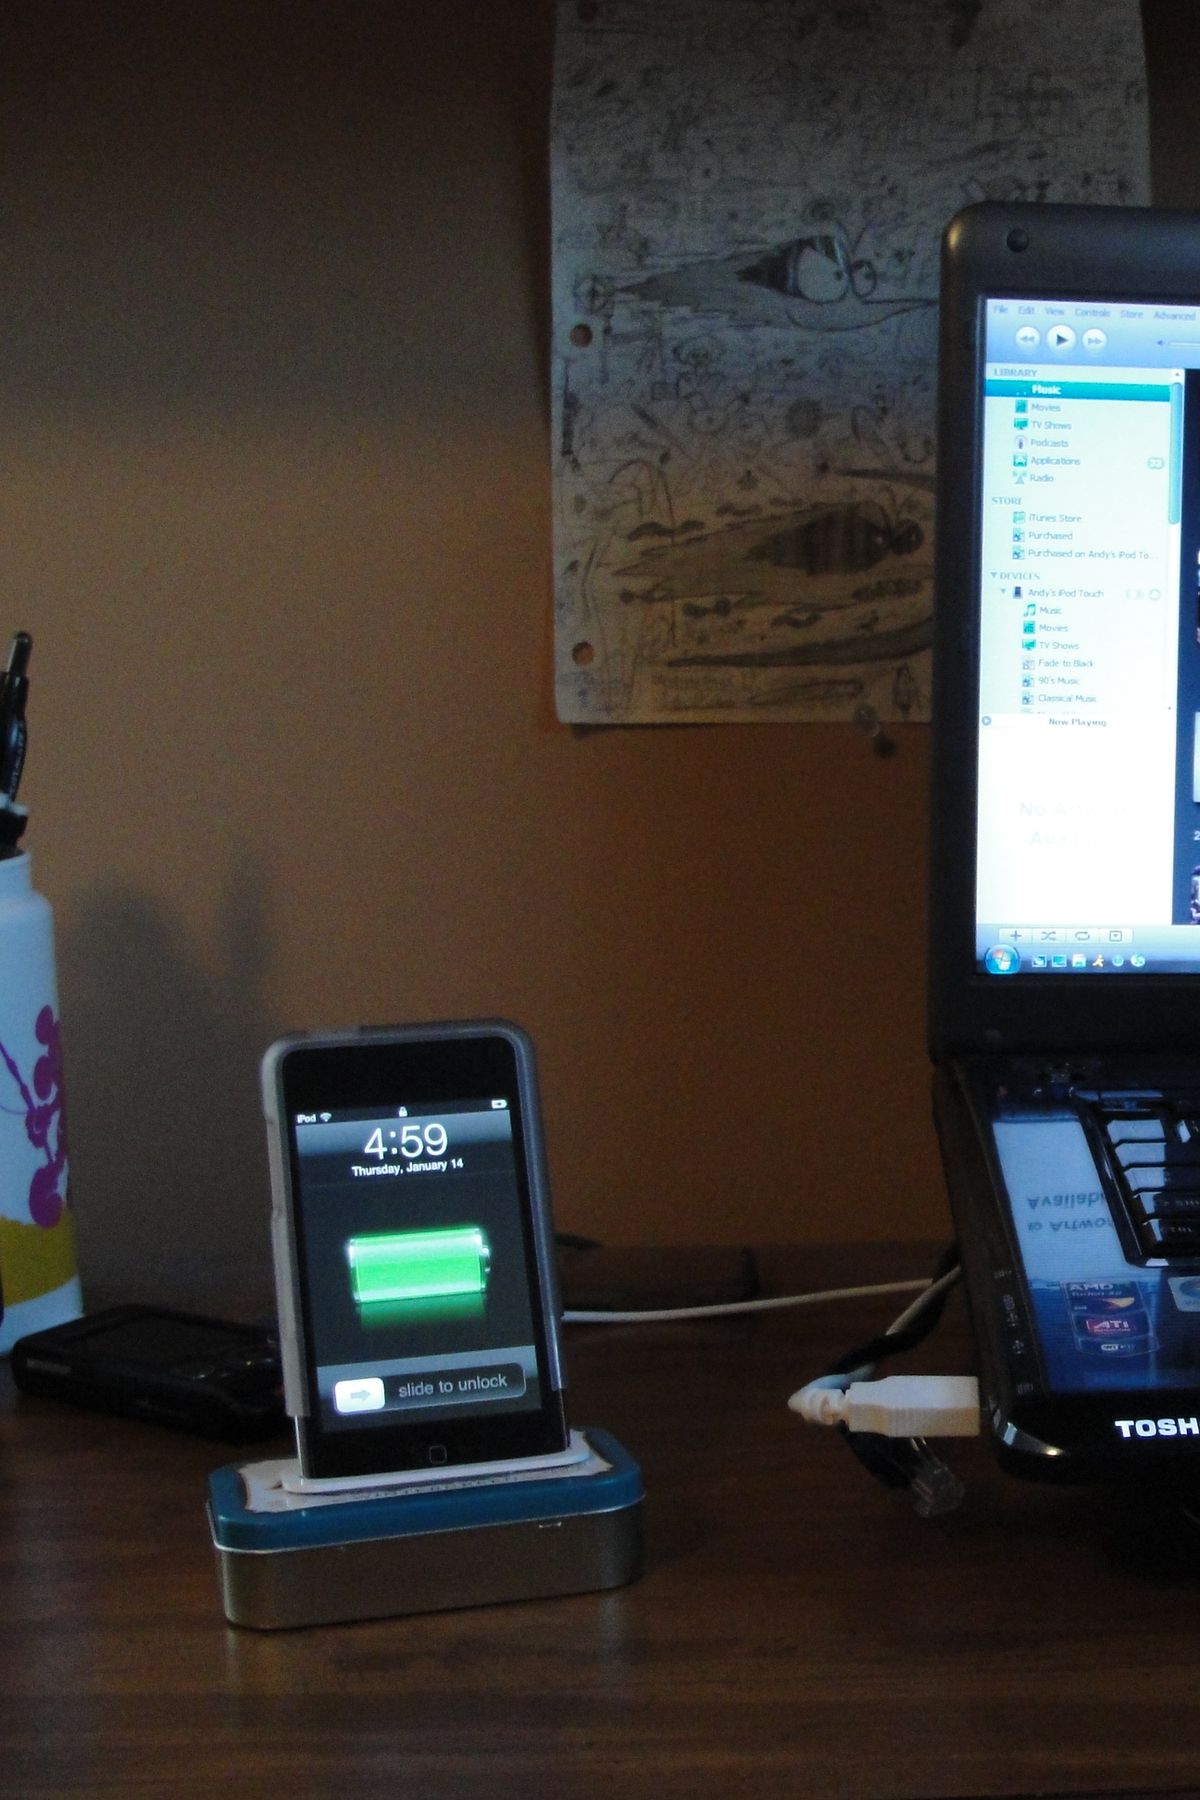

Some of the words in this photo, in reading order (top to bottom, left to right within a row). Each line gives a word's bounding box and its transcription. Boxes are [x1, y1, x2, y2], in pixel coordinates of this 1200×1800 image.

[1018, 306, 1035, 315] Edit
[1045, 307, 1065, 316] View
[1074, 308, 1111, 318] Controls
[1120, 310, 1143, 319] Store
[1153, 311, 1196, 321] Advanced
[994, 368, 1038, 377] LIBRARY
[1032, 384, 1062, 395] Music
[1032, 404, 1061, 412] Movies
[1032, 421, 1043, 429] TV
[1044, 422, 1072, 430] Shows
[1031, 439, 1069, 448] Podcasts
[1031, 457, 1081, 466] Applications
[1030, 474, 1054, 482] Radio
[1029, 514, 1056, 522] iTunes
[1060, 514, 1082, 523] Store
[1028, 532, 1073, 540] Purchased
[1028, 549, 1073, 558] Purchased
[1088, 550, 1116, 560] Andy's
[1118, 551, 1136, 559] iPod
[1028, 589, 1056, 599] Andy's
[1080, 590, 1104, 598] Touch
[1040, 606, 1063, 615] Music
[1039, 624, 1068, 632] Movies
[1052, 642, 1080, 650] Shows
[1038, 659, 1059, 667] Fade
[1057, 677, 1080, 685] Music
[1075, 695, 1098, 703] Music
[1049, 718, 1068, 726] Now
[1071, 718, 1107, 728] Playing
[297, 1114, 316, 1124] iPod
[364, 1123, 448, 1160] 4:59
[352, 1164, 404, 1176] Thursday,
[406, 1160, 448, 1173] January
[451, 1158, 464, 1169] 14
[398, 1378, 434, 1398] slide
[438, 1378, 454, 1393] to
[458, 1373, 508, 1392] unlock
